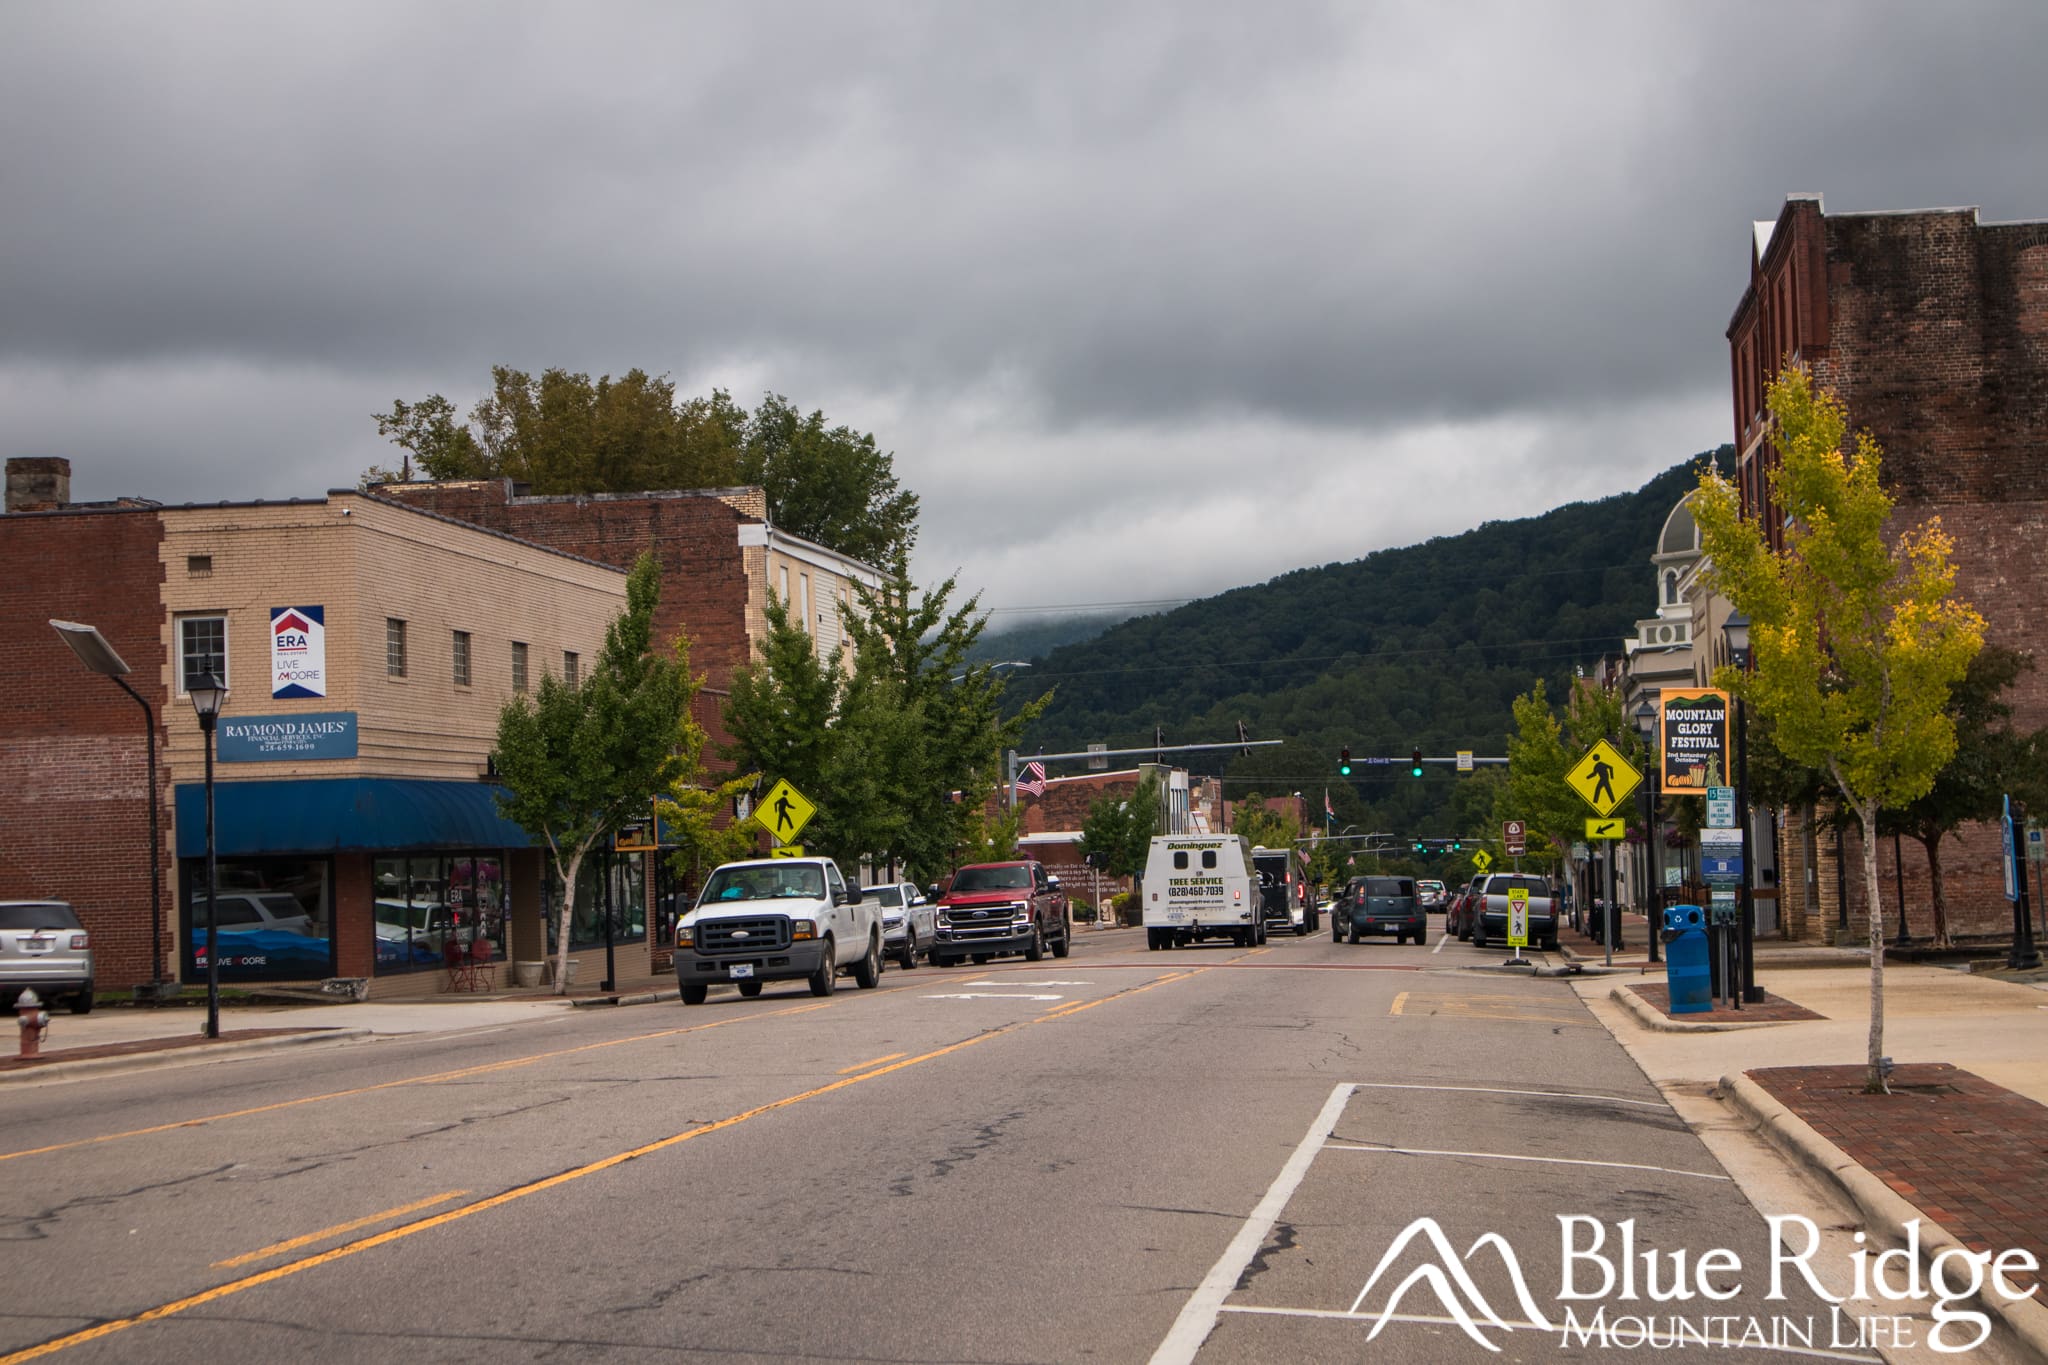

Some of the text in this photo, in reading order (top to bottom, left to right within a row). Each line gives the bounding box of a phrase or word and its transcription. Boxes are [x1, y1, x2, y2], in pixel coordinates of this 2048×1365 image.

[276, 635, 307, 648] ERA
[276, 660, 299, 670] LIVE
[278, 670, 320, 681] MOORE
[1665, 709, 1725, 721] MOUNTAIN
[225, 723, 296, 737] RAYMOND
[1677, 723, 1713, 735] GLORY
[259, 743, 315, 752] 828-659-1600
[1671, 737, 1720, 748] FESTIVAL
[1680, 752, 1708, 760] Saturday
[1709, 788, 1717, 799] 15
[1167, 842, 1223, 850] Dominguez
[1168, 877, 1223, 886] TREE SERVICE
[450, 889, 463, 903] ERA
[1168, 886, 1224, 896] (828)460-7039
[195, 957, 209, 965] ER
[216, 957, 232, 966] IVE
